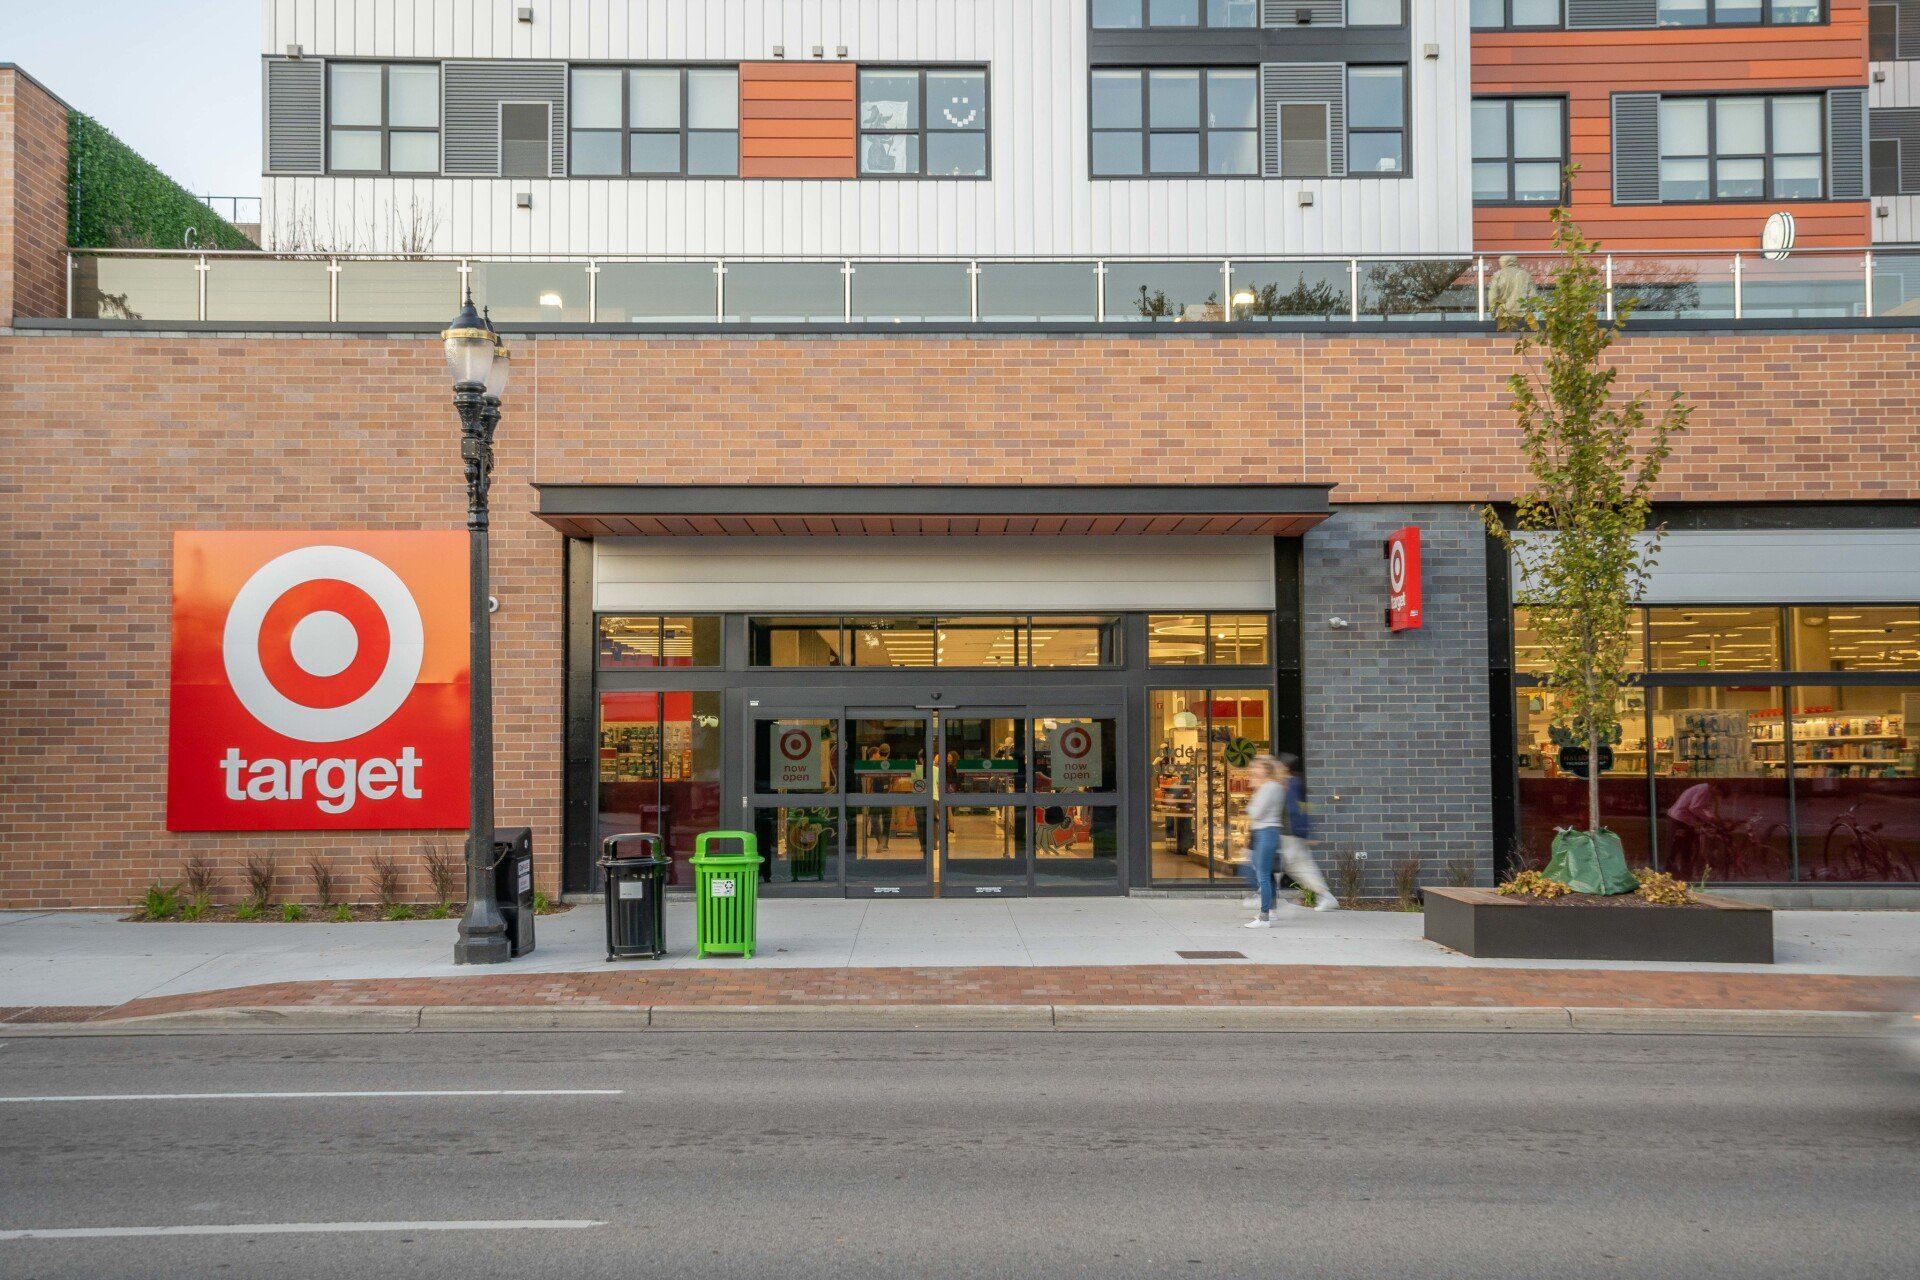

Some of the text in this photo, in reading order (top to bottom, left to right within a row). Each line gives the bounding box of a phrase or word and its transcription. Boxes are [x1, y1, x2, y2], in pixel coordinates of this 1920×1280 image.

[784, 764, 807, 772] now
[1064, 762, 1088, 770] now
[219, 746, 423, 814] target
[782, 774, 809, 782] open
[1063, 772, 1090, 781] open
